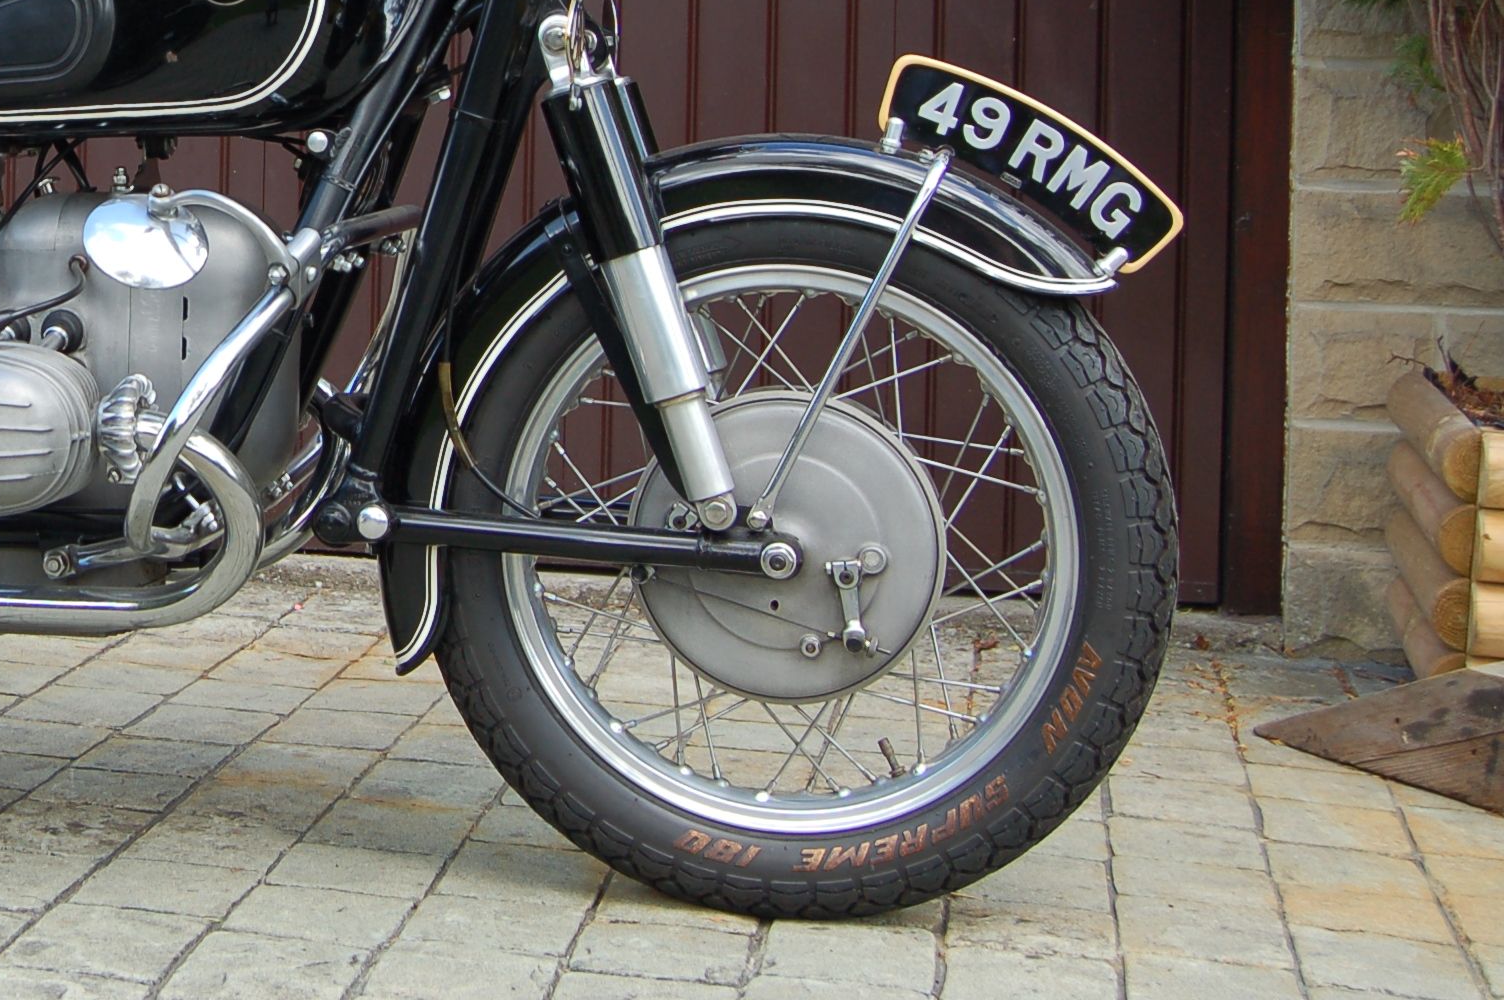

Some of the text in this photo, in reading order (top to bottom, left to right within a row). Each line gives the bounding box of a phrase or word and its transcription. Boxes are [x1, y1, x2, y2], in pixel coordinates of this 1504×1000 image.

[917, 82, 1143, 240] 49 RMG
[1040, 640, 1103, 756] AVON
[791, 774, 1010, 873] SUPREME
